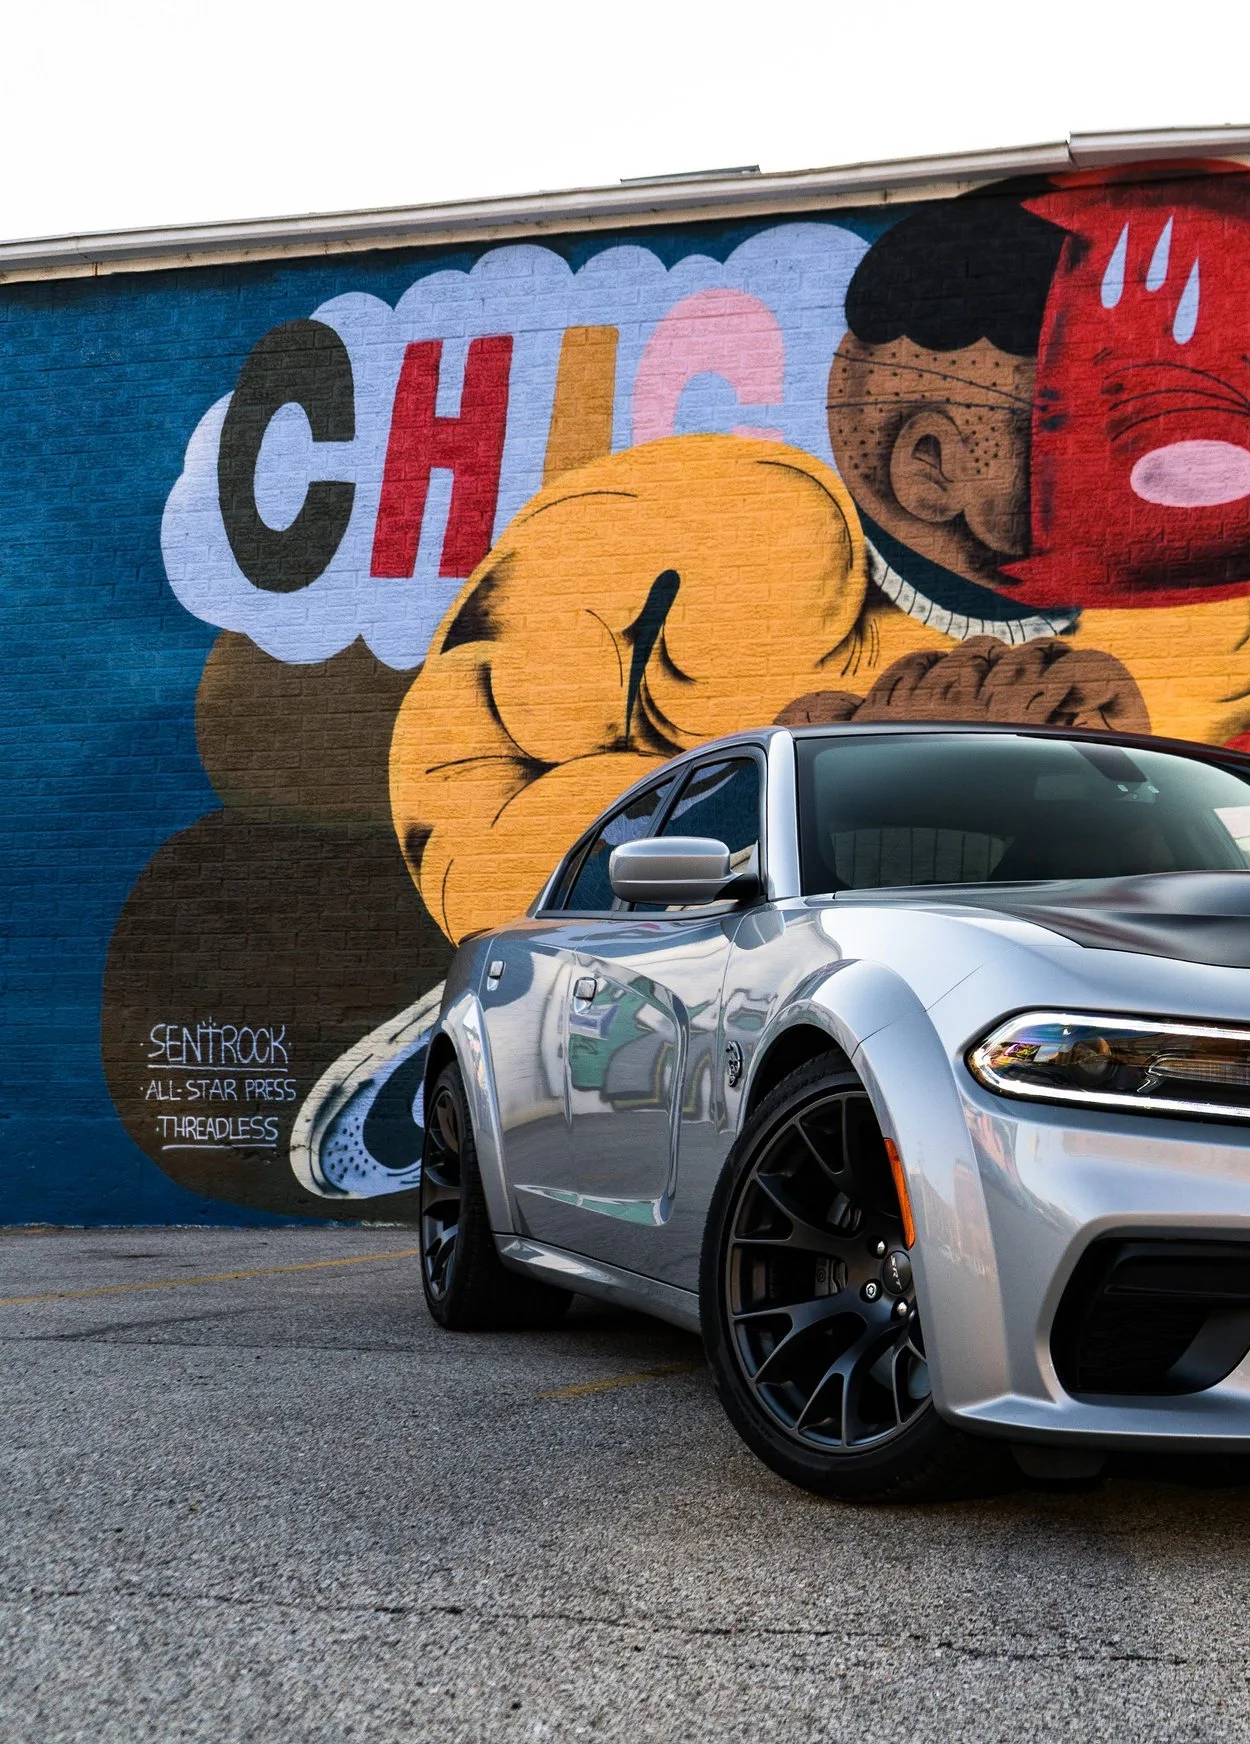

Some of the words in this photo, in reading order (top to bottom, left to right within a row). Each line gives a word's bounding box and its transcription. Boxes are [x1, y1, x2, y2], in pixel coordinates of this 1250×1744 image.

[148, 1023, 288, 1063] SENTROCK
[145, 1079, 237, 1101] ALL-STAR
[245, 1079, 297, 1101] PRESS
[157, 1116, 279, 1140] THREADLESS
[890, 1255, 903, 1290] SRT
